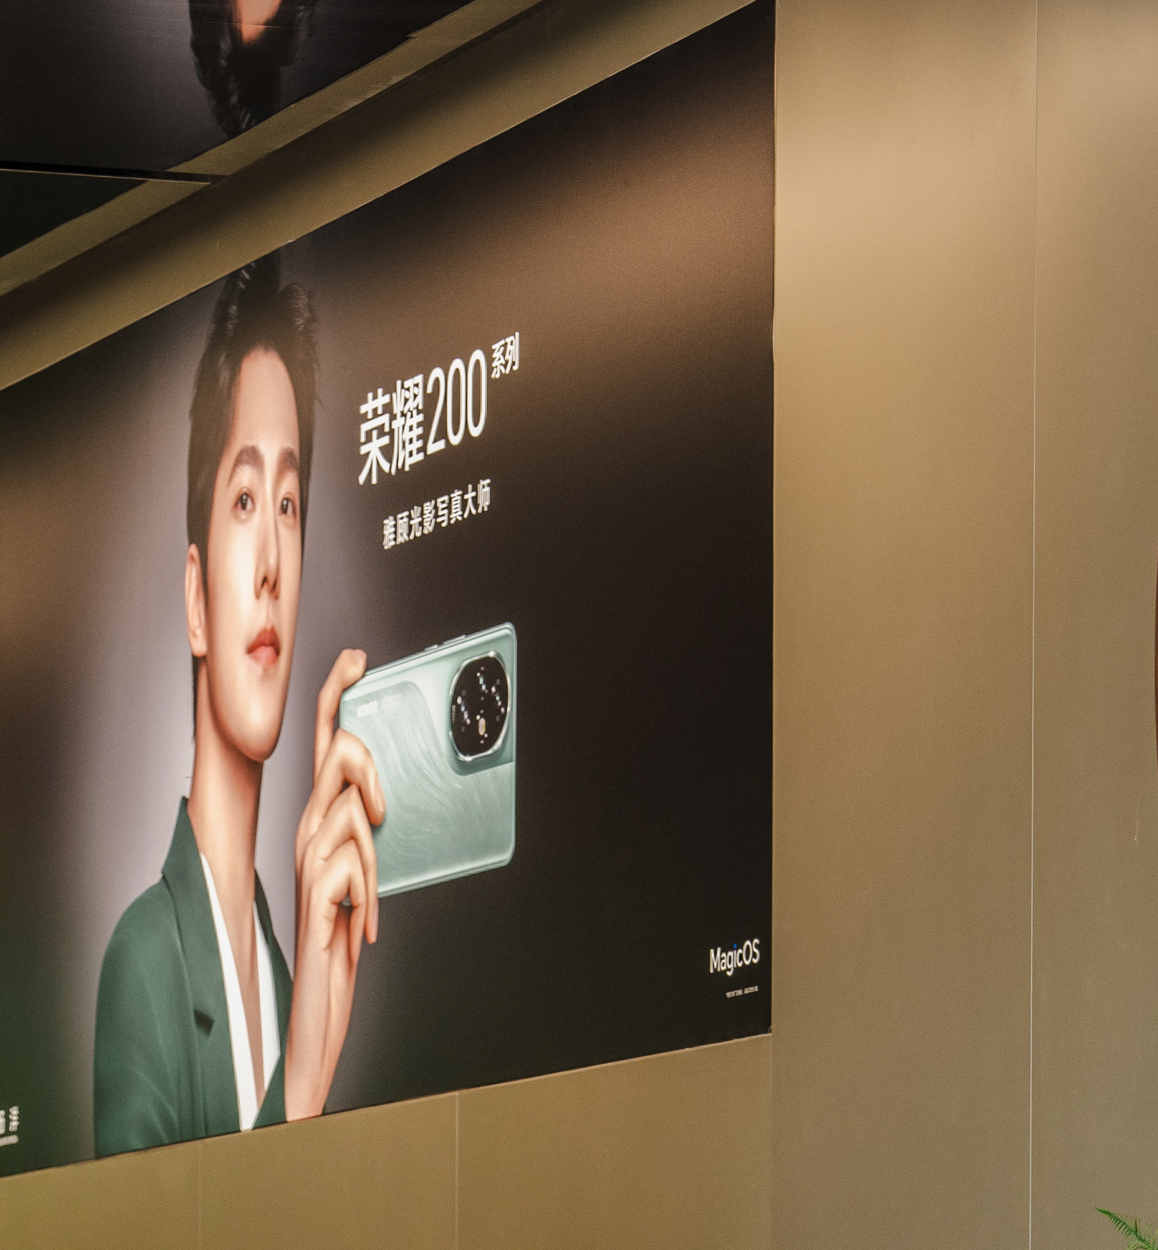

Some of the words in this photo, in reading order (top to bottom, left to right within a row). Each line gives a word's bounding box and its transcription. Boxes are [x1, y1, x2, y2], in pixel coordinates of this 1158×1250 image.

[382, 478, 492, 550] 雅顾光影写真大师
[709, 938, 761, 977] MagicOS
